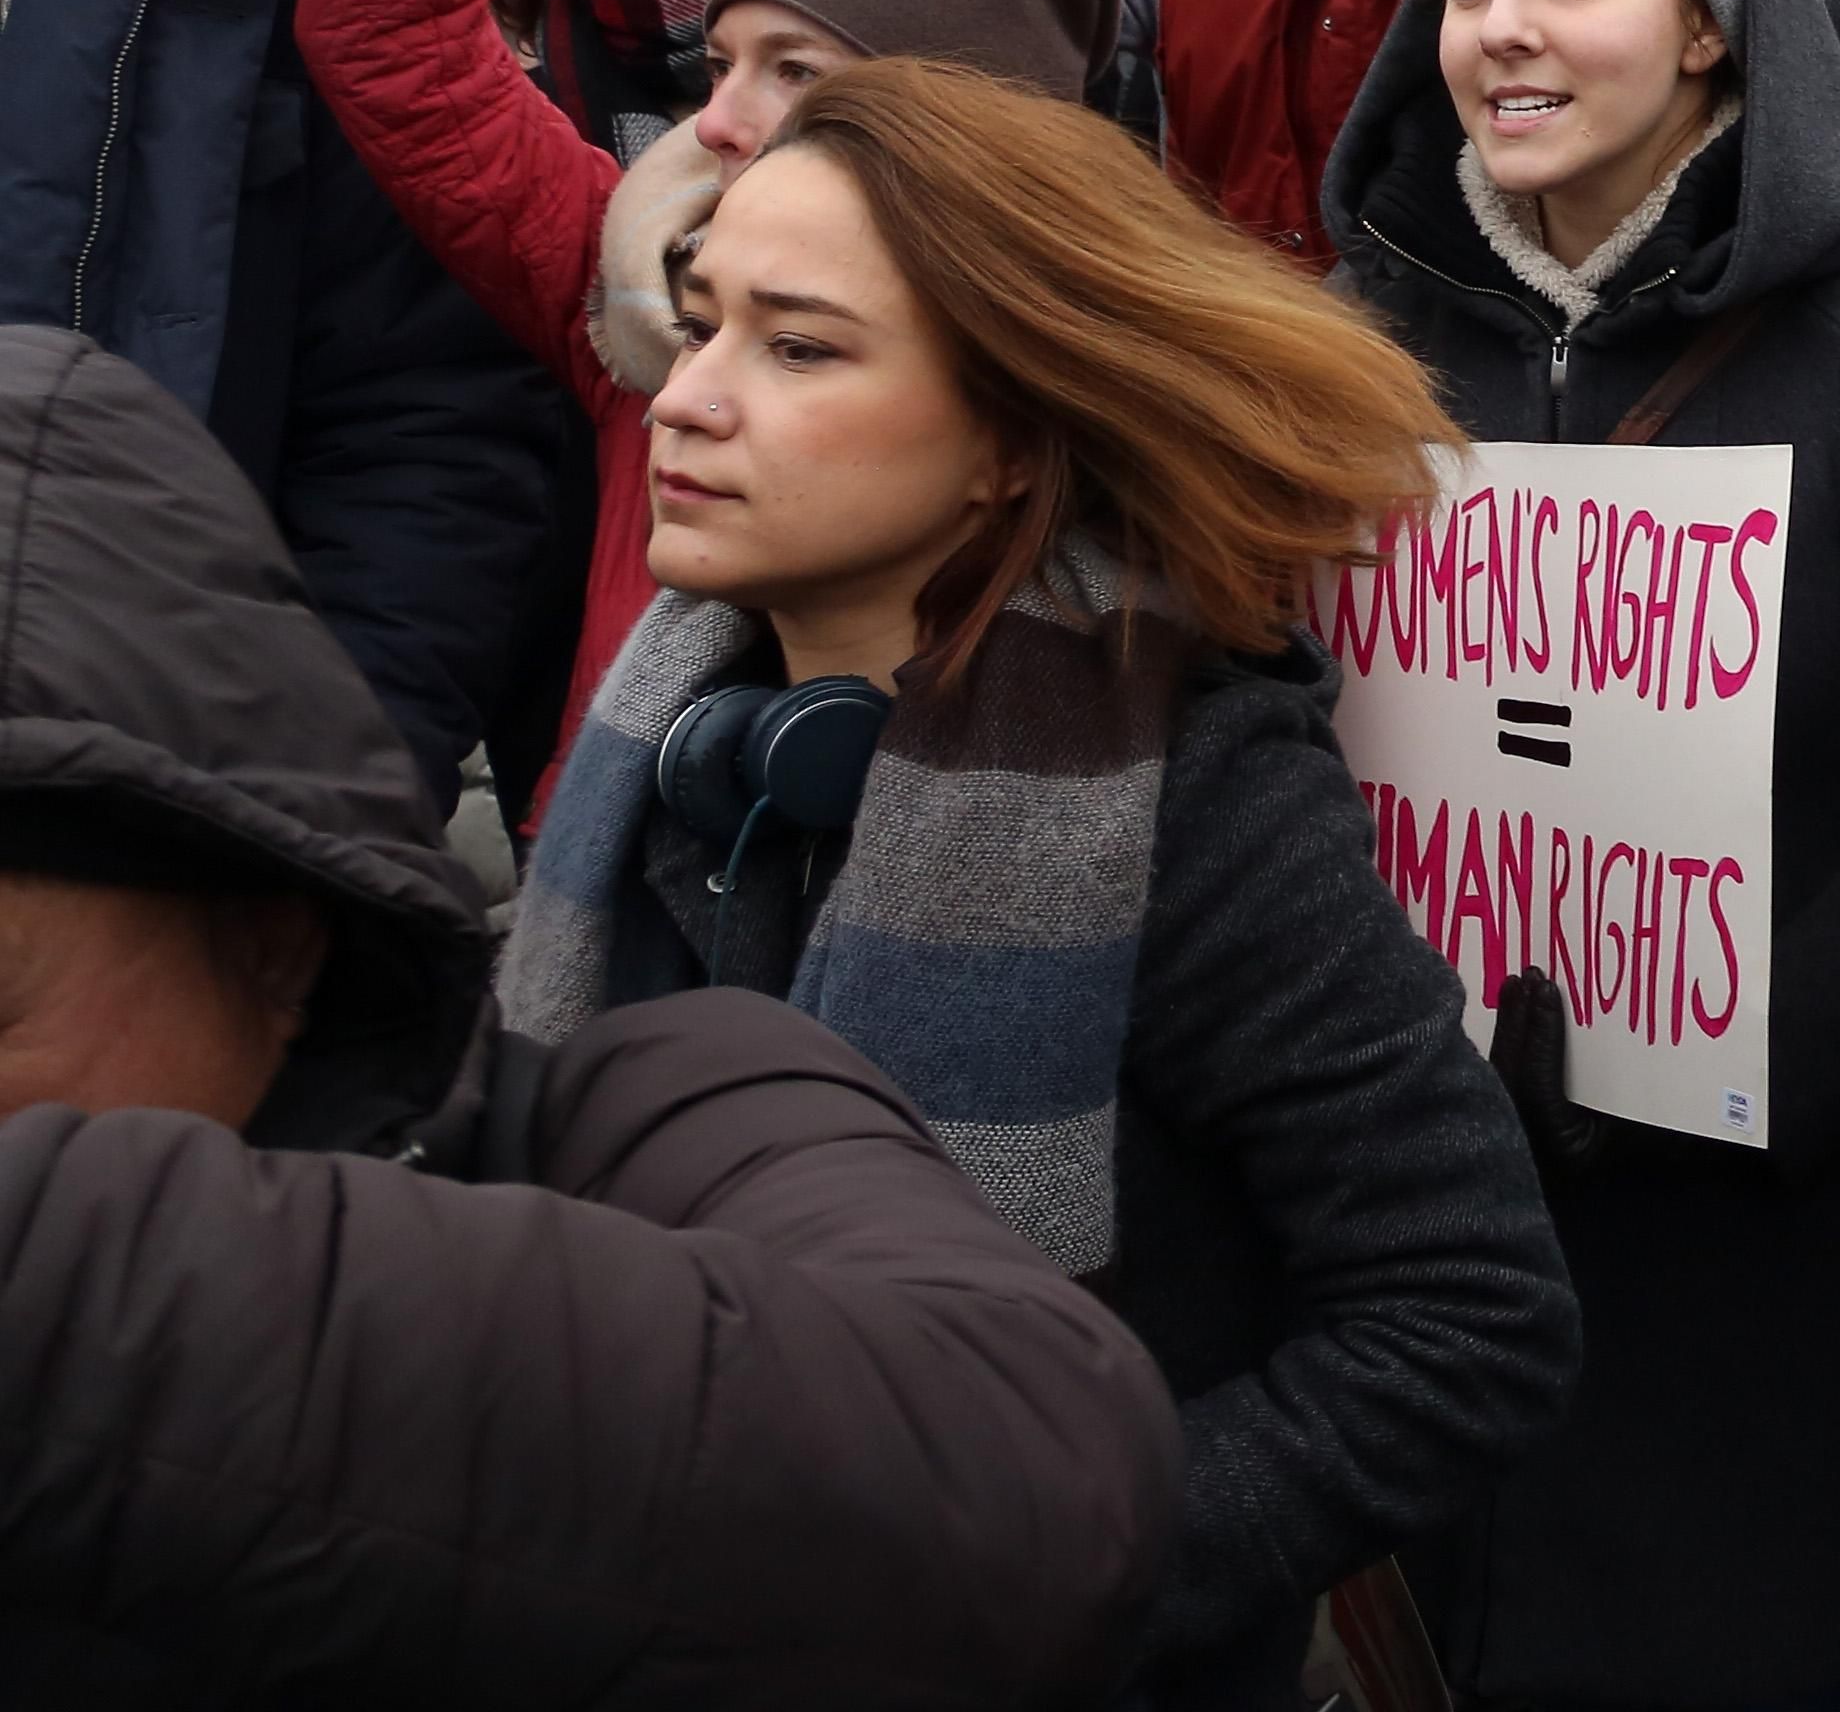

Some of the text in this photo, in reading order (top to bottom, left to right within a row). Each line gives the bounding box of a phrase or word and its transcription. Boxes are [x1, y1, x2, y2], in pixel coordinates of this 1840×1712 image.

[1572, 498, 1778, 711] RIGHTS
[1359, 781, 1744, 1046] MAN RIGHTS
